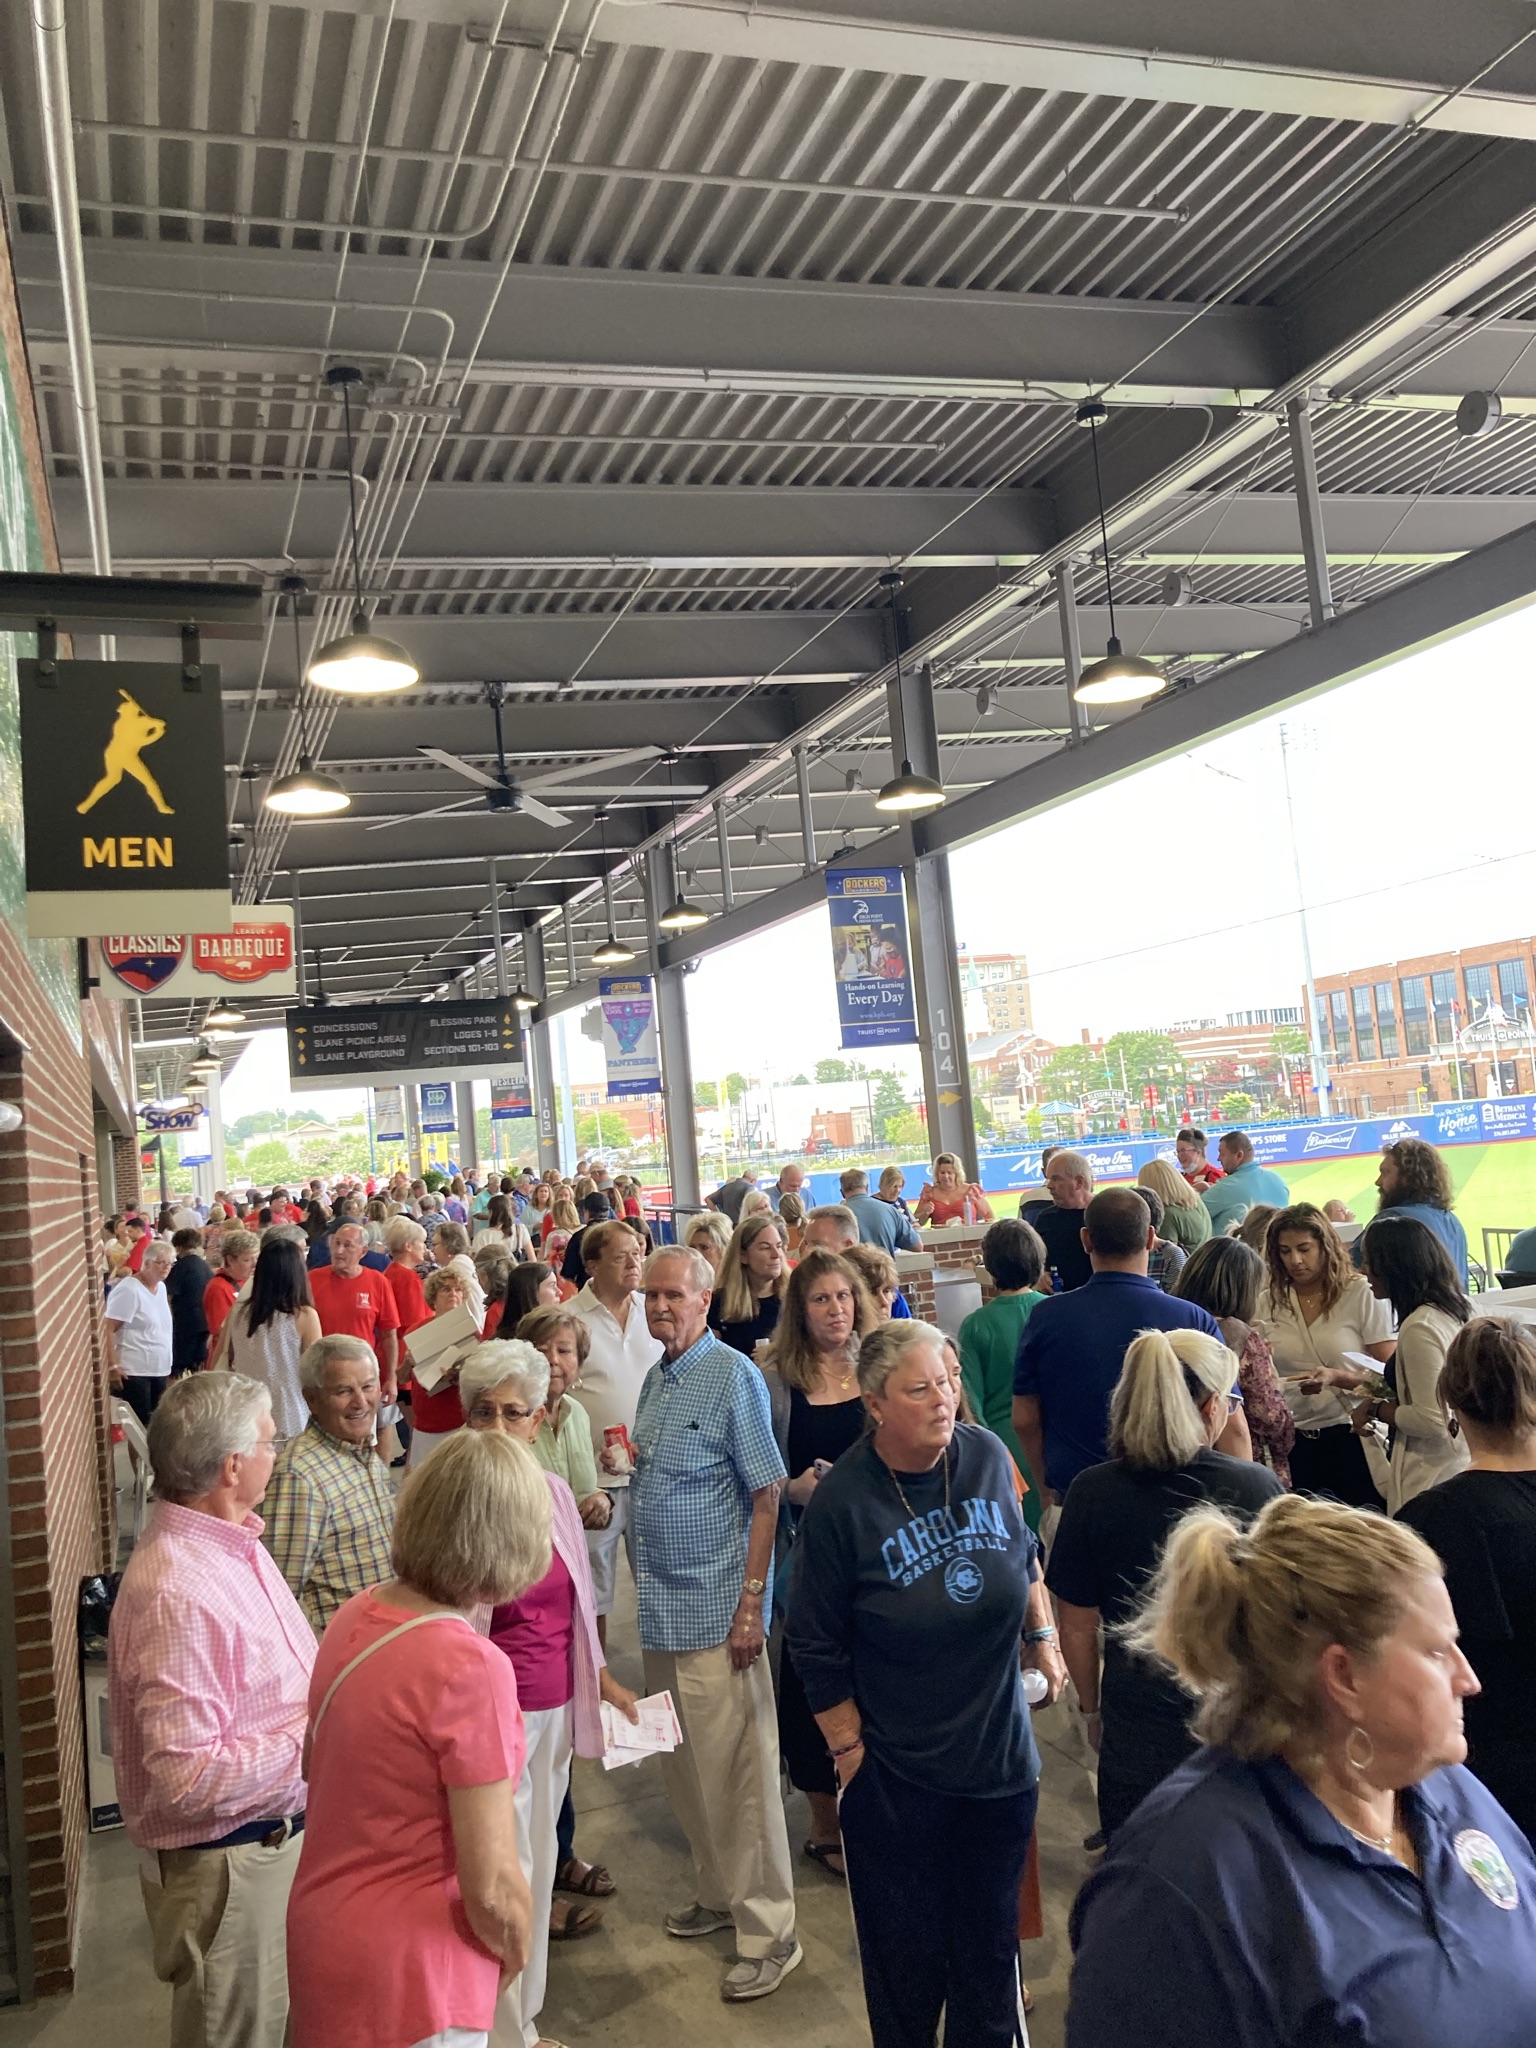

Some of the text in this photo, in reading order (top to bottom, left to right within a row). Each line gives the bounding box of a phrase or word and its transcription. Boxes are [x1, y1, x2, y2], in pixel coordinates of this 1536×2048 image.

[83, 837, 173, 868] MEN
[846, 878, 885, 892] ROCKERS
[109, 934, 181, 953] CLASSICS
[200, 938, 285, 959] BARBEQUE
[845, 981, 905, 992] Hands-on Learning
[847, 991, 904, 1007] Every Day
[313, 1022, 378, 1034] CONCESSIONS
[430, 1017, 472, 1027] BLESSING
[473, 1016, 498, 1025] PARK
[454, 1029, 498, 1039] LOGES 1-8
[314, 1035, 407, 1048] SLANE PICNIC AREAS
[937, 1009, 954, 1073] 104
[314, 1049, 405, 1062] SLANE PLAYGROUND
[424, 1043, 499, 1055] SECTIONS 101-103
[607, 1057, 657, 1067] PANTHERS
[491, 1075, 529, 1087] WESLEYAN
[542, 1098, 552, 1131] 103
[1494, 1104, 1526, 1113] BETHANY
[146, 1111, 195, 1130] SHOW
[1439, 1113, 1478, 1133] Home
[1495, 1112, 1527, 1121] MEDICAL
[1264, 1133, 1288, 1144] STORE
[1307, 1135, 1351, 1146] Budweiser
[1400, 1130, 1420, 1138] RIDGE
[881, 1498, 1011, 1581] CAROLINA
[902, 1537, 1008, 1587] BASKETBALL
